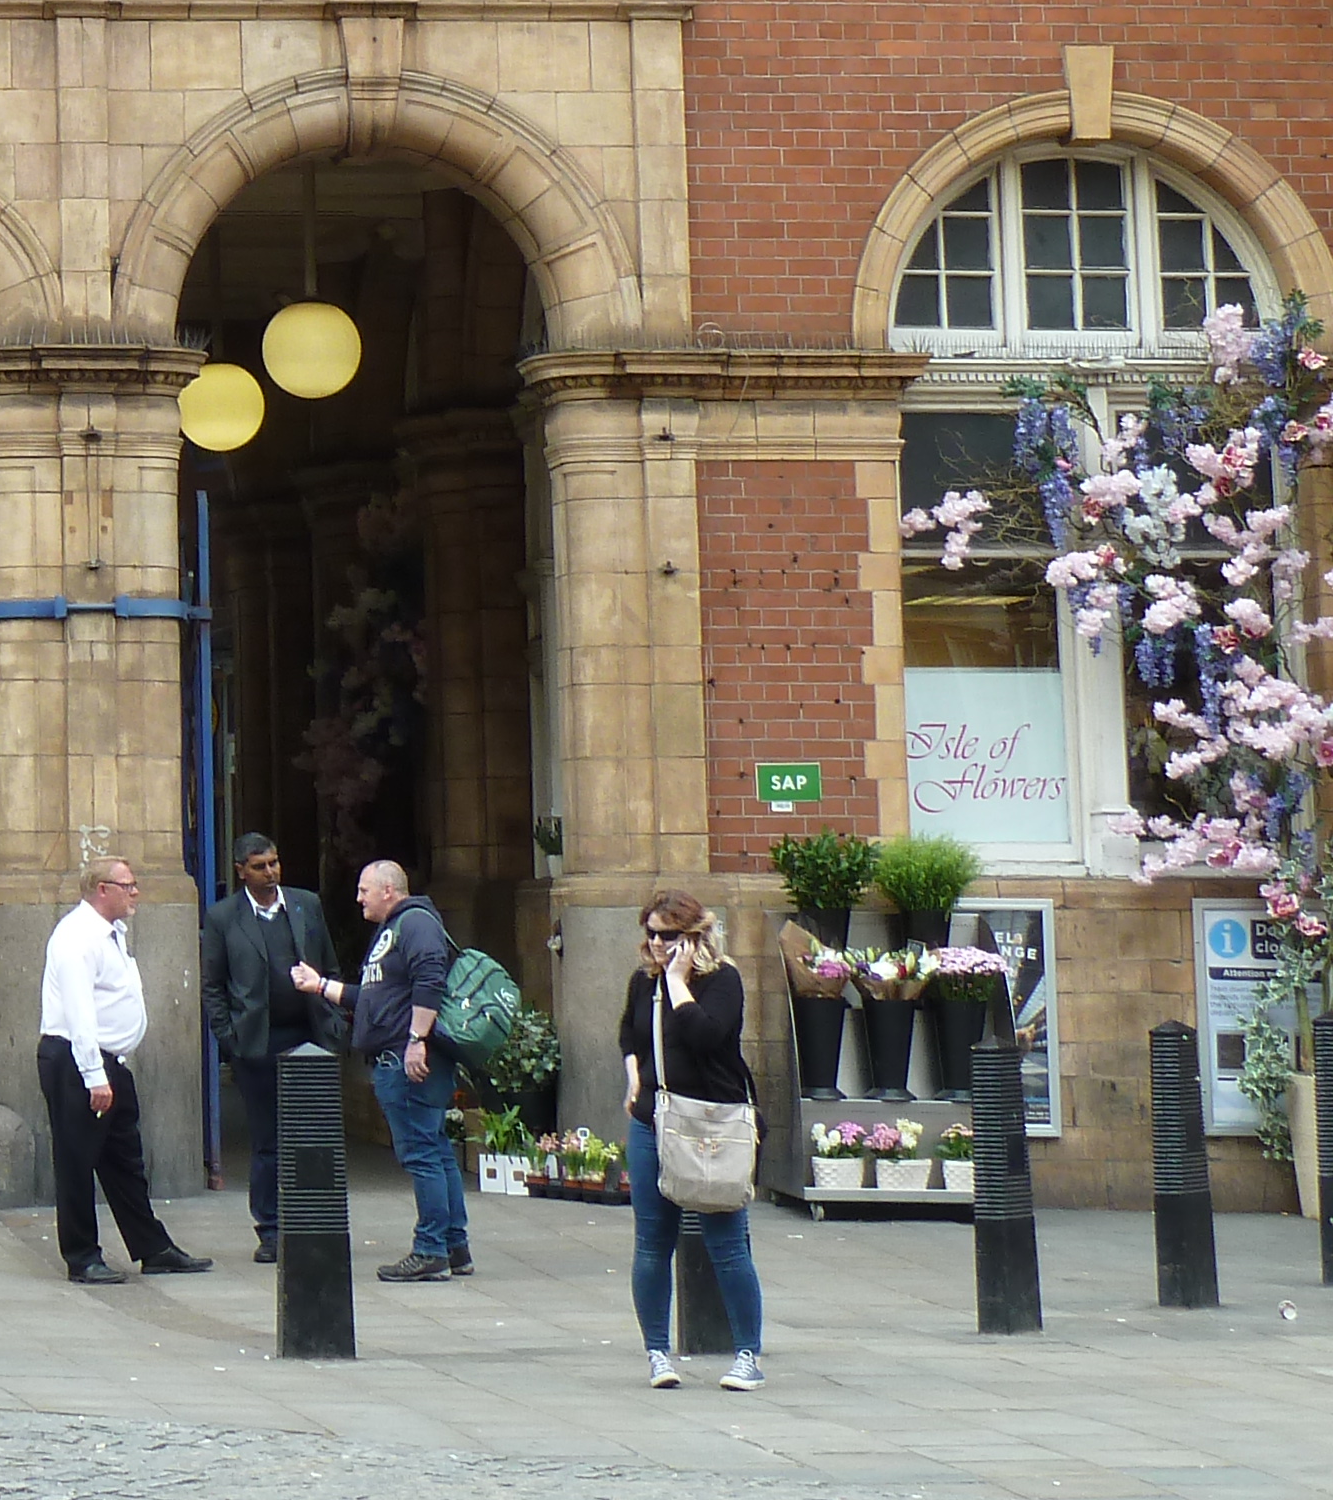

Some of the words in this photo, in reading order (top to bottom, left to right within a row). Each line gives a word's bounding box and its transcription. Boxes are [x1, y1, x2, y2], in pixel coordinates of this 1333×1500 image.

[906, 723, 980, 760] Isle
[989, 723, 1032, 774] of
[770, 774, 808, 791] SAP
[913, 763, 1067, 814] Flowers
